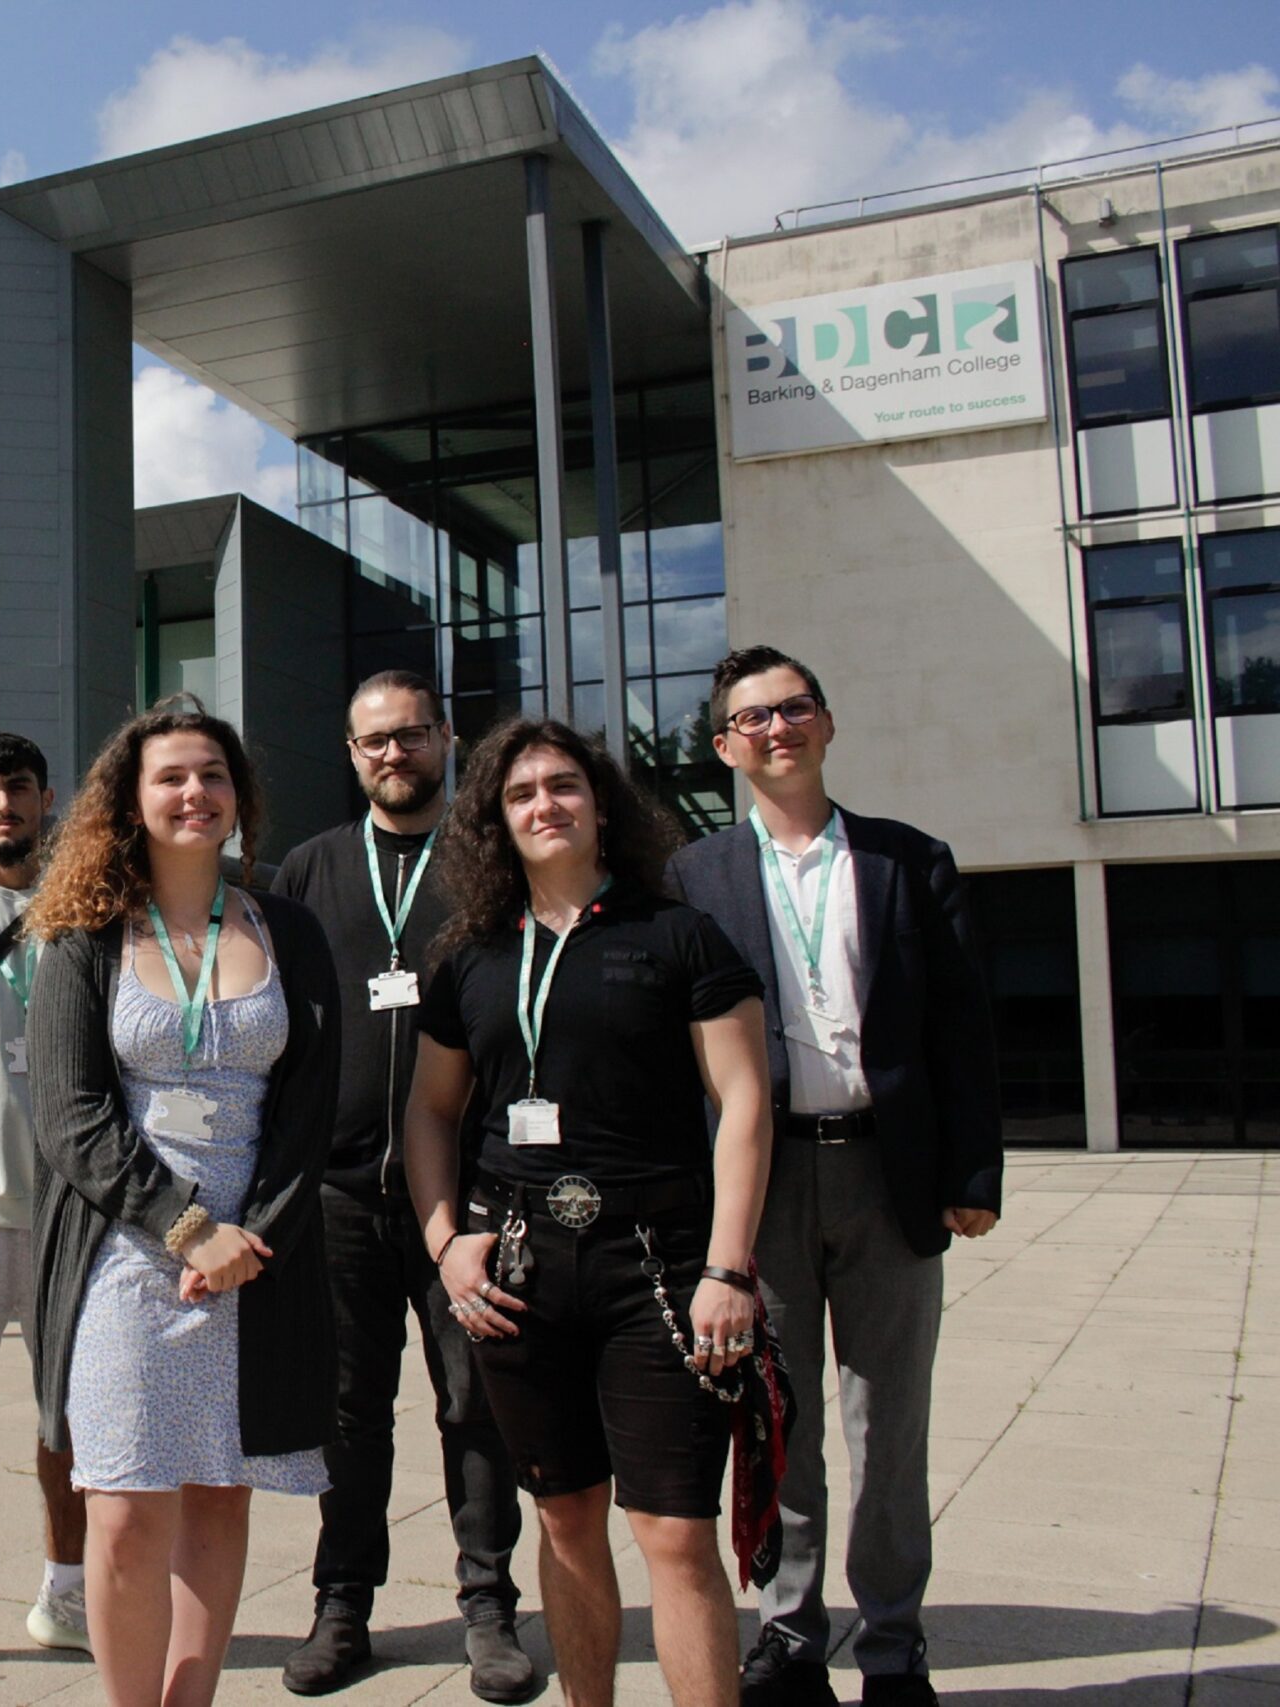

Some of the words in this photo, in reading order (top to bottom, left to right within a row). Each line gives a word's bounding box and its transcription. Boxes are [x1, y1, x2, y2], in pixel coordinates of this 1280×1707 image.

[745, 293, 941, 378] BDC
[747, 381, 816, 406] Barking
[822, 378, 834, 394] &
[840, 364, 941, 392] Dagenham
[947, 352, 1021, 376] College
[874, 410, 905, 424] Your
[909, 404, 945, 419] route
[949, 402, 964, 413] to
[968, 394, 1026, 411] success
